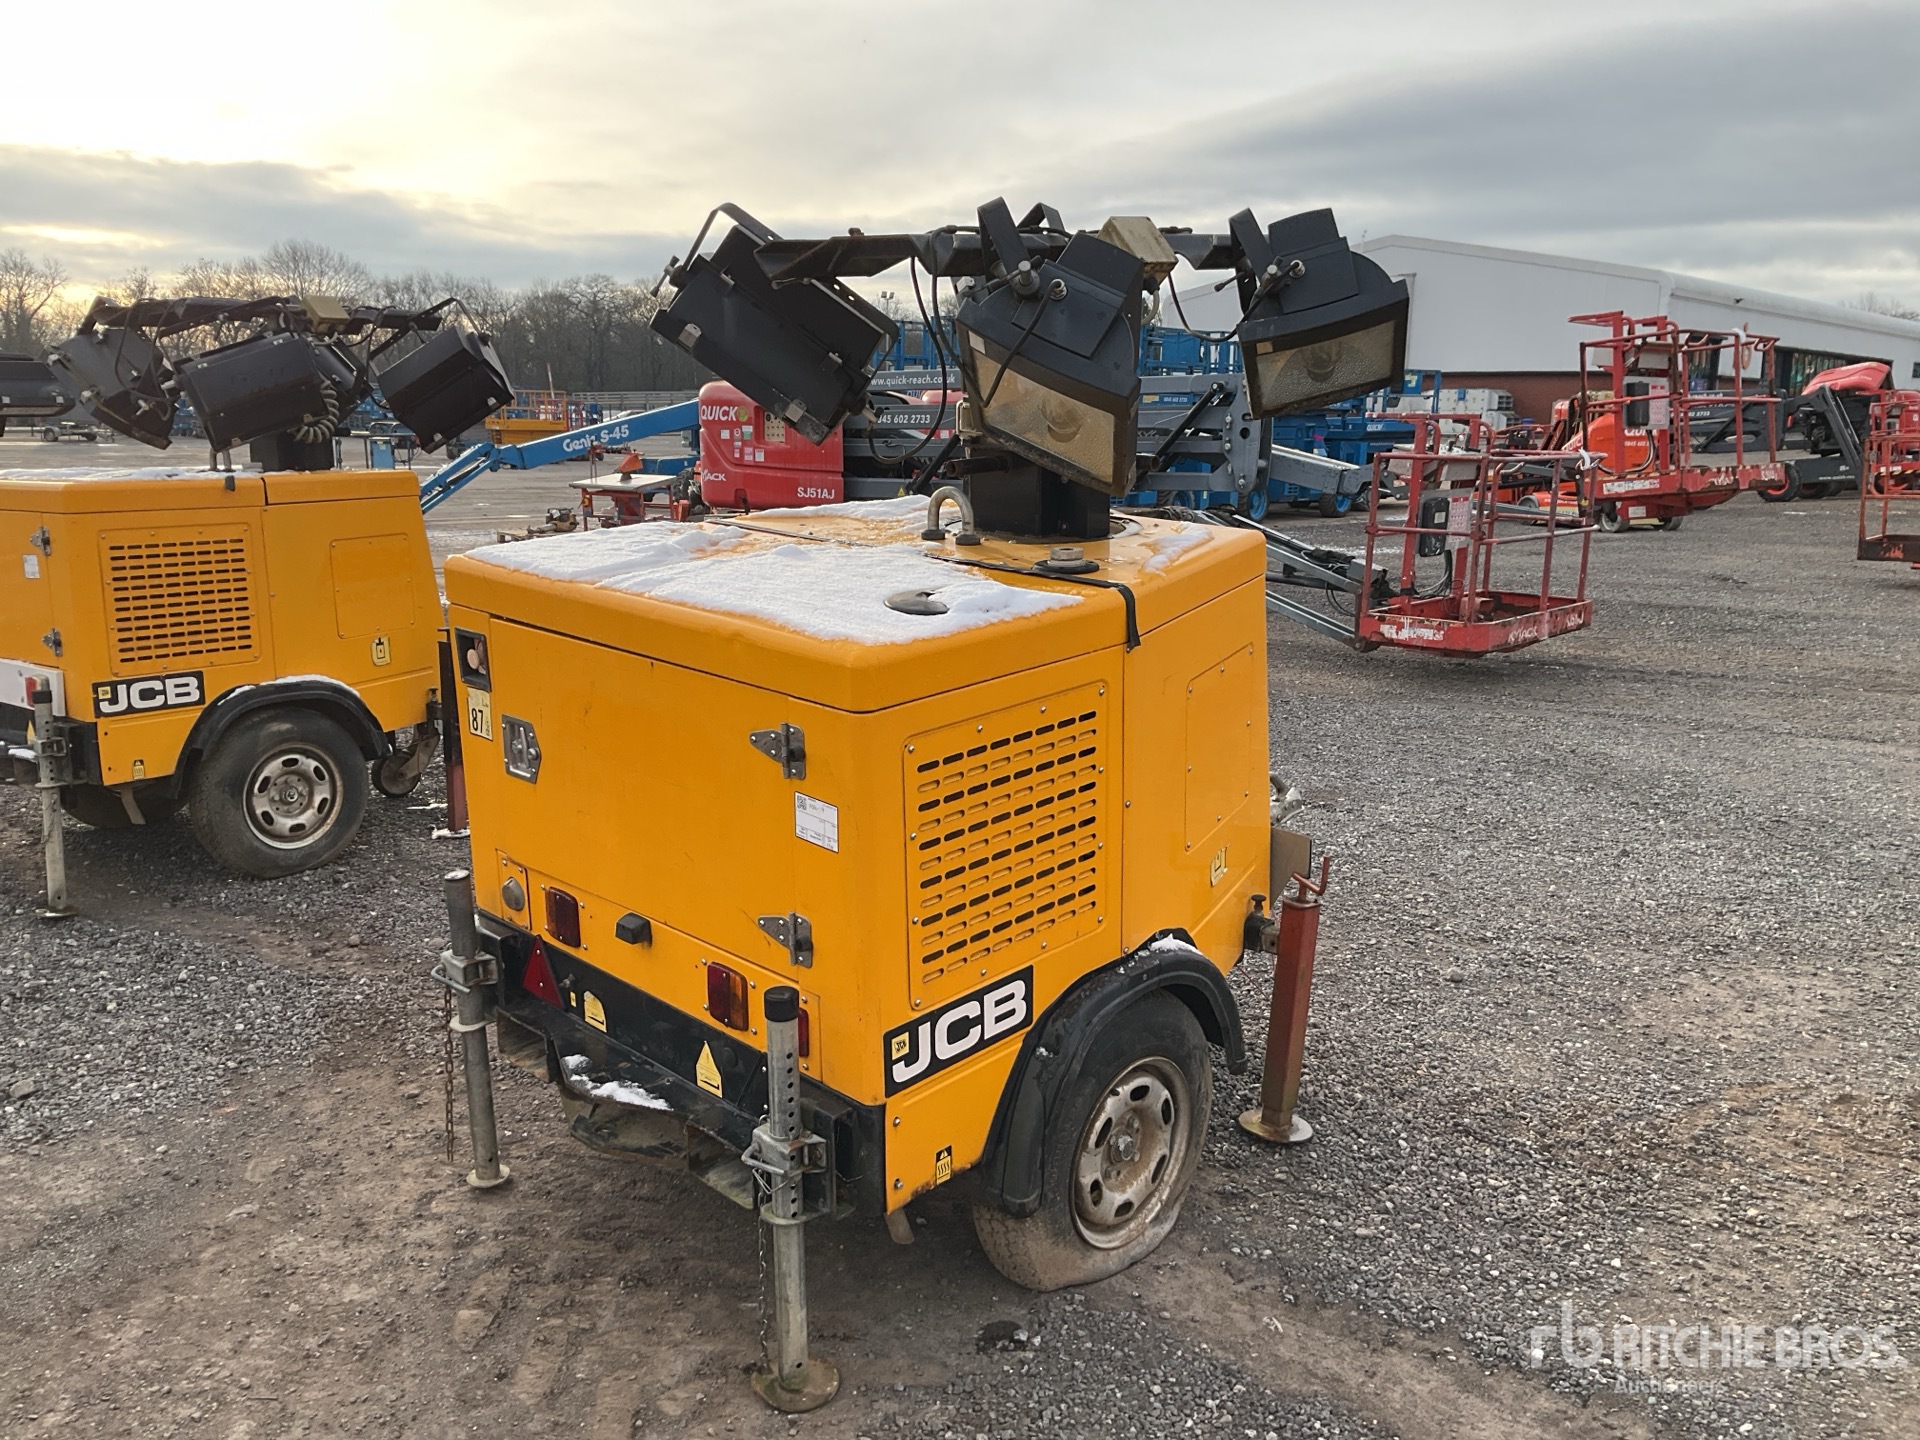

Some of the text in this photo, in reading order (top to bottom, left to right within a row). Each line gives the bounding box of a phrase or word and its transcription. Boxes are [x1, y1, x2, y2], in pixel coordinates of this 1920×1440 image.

[871, 374, 955, 387] ww.quick-reach.couk
[701, 405, 738, 421] QUICK
[893, 414, 909, 424] 602
[910, 414, 931, 424] 2733
[600, 424, 629, 443] S-45
[797, 487, 835, 499] SJ51AJ
[99, 676, 201, 713] JCB
[471, 707, 484, 734] 87
[892, 979, 1027, 1083] JCB
